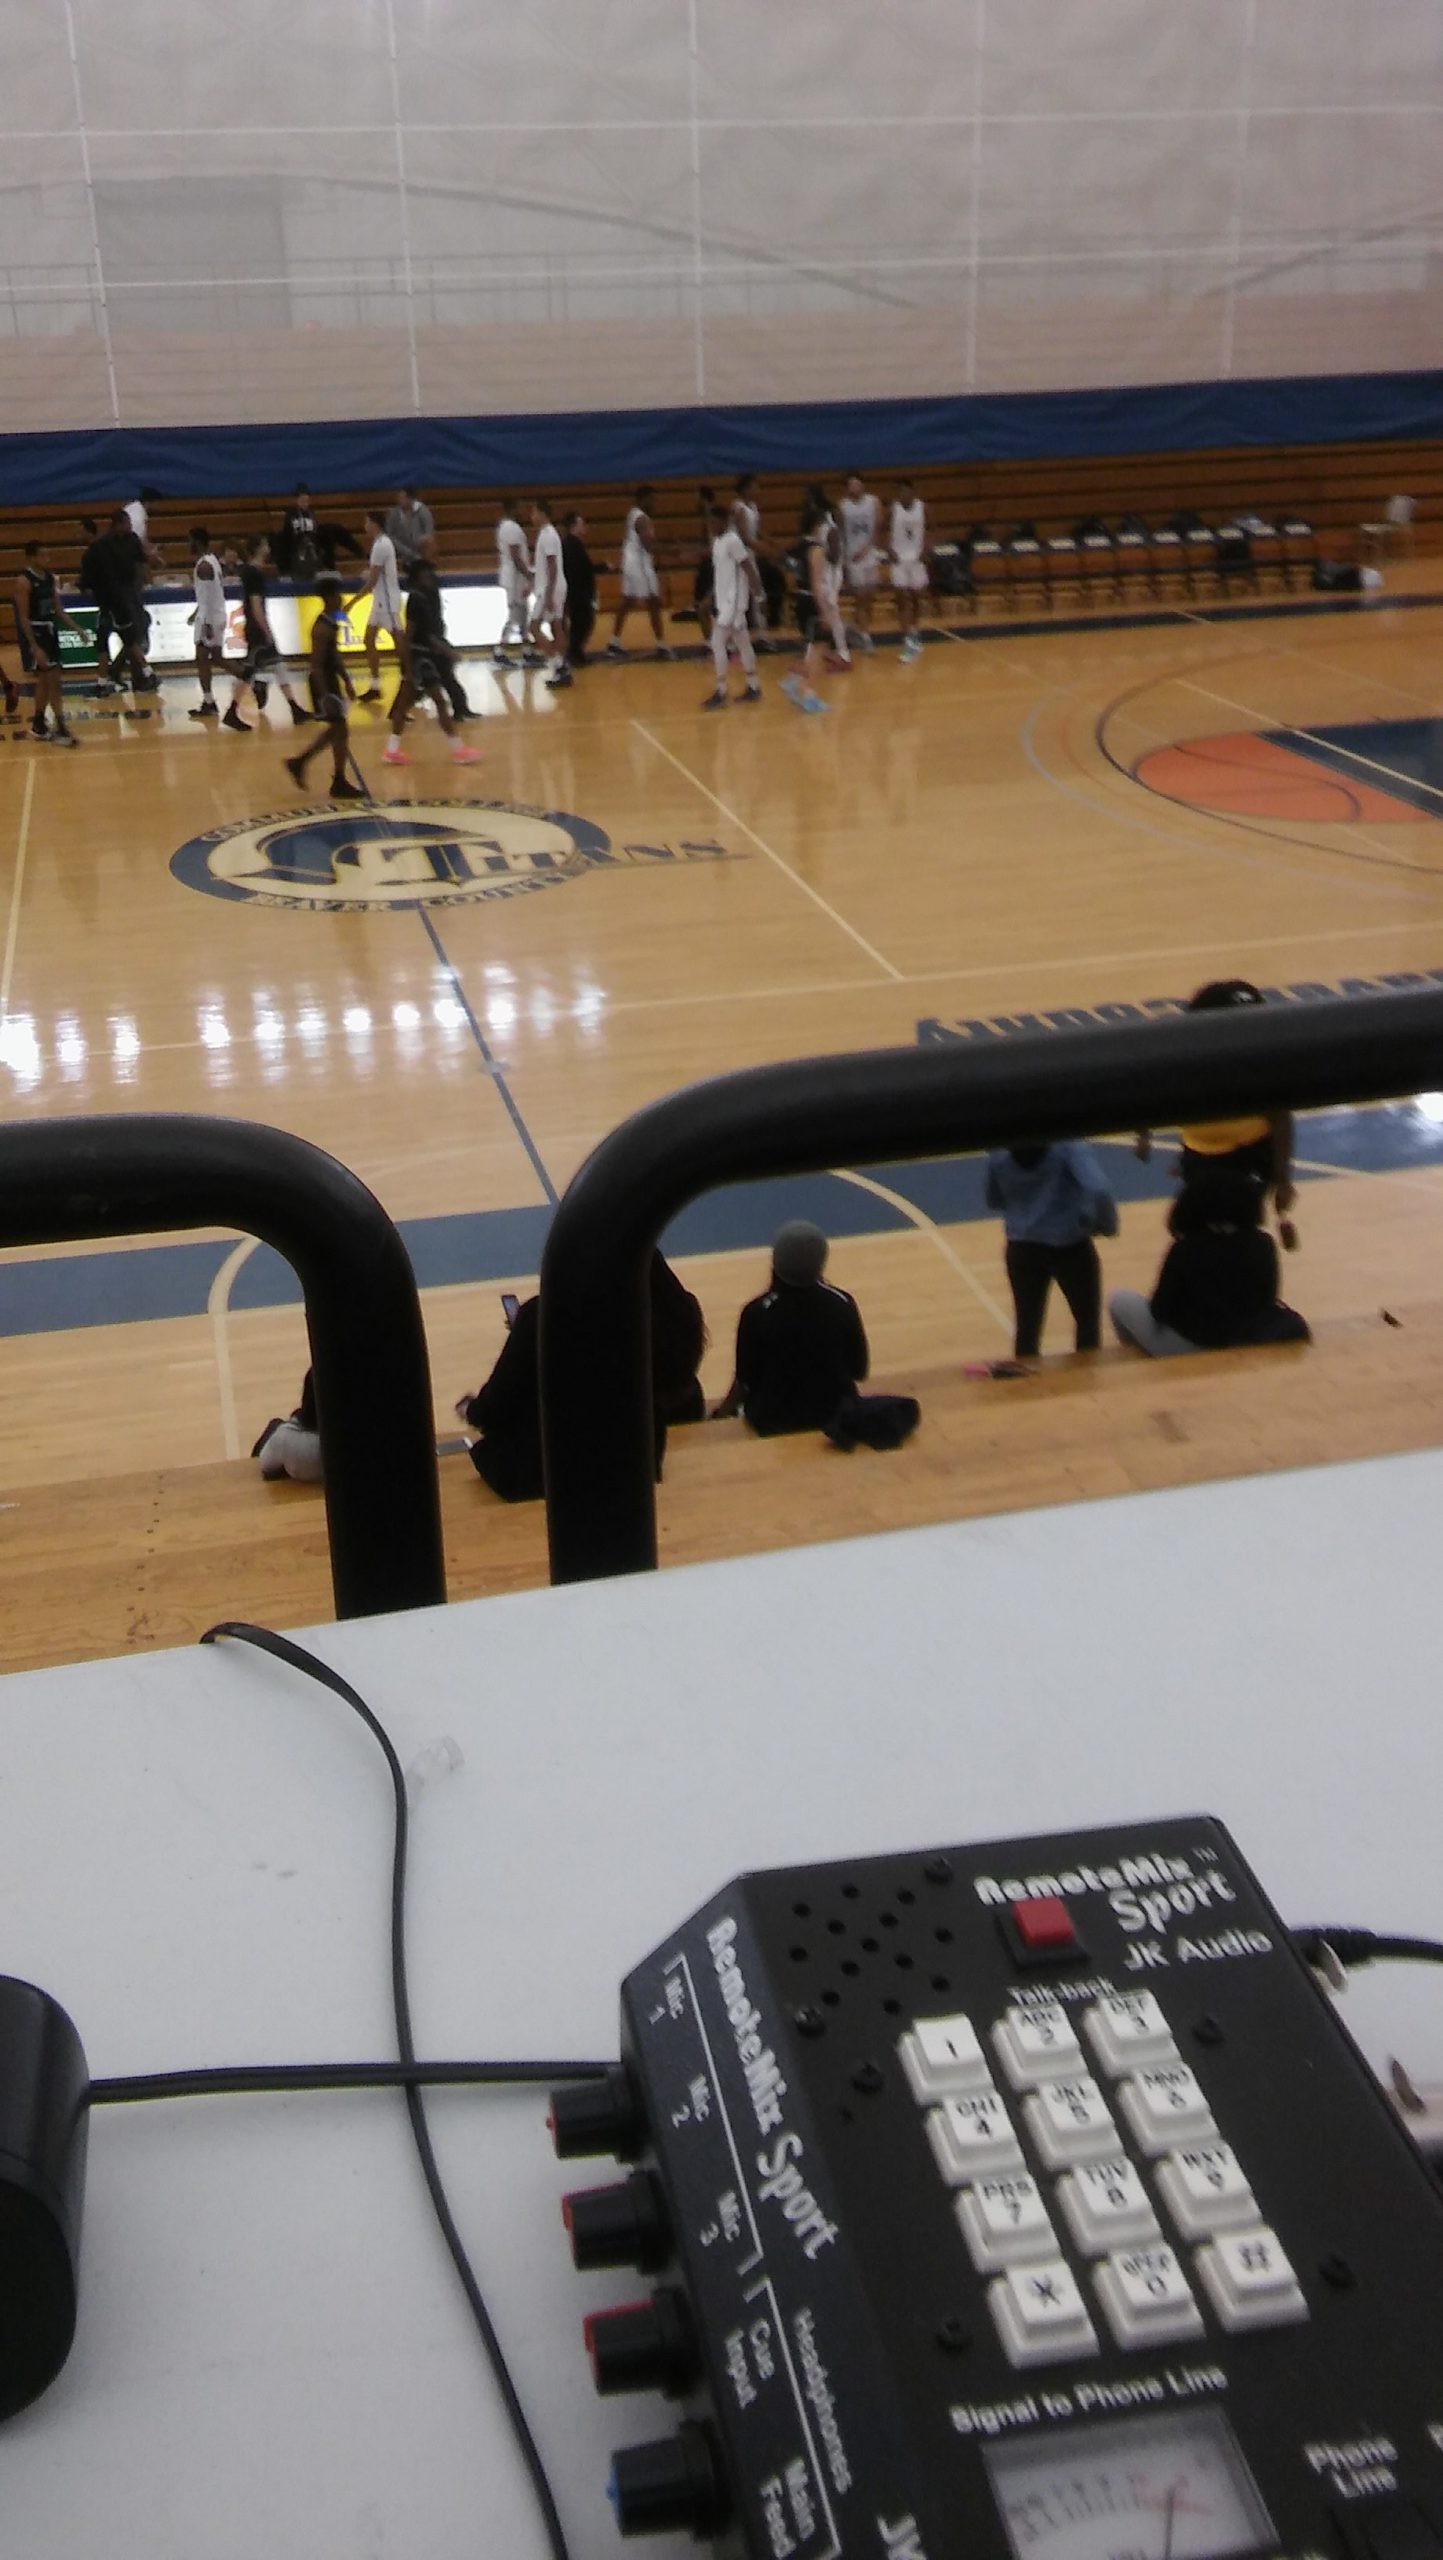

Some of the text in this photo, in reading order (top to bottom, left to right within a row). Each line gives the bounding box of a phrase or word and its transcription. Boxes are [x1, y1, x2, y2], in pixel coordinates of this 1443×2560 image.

[973, 1853, 1194, 1906] RemoteMix
[1108, 1869, 1237, 1935] Sport
[1124, 1928, 1273, 1972] JK Audio
[649, 2004, 667, 2025] 1
[664, 1975, 685, 2020] Mic
[945, 2037, 960, 2060] 1
[1039, 2024, 1056, 2046] 2
[687, 2073, 710, 2122] Mic
[706, 1916, 840, 2260] RemoteMix Sport
[1166, 2090, 1186, 2109] 6
[671, 2104, 691, 2129] 2
[976, 2116, 993, 2139] 4
[1070, 2103, 1091, 2123] 5
[1107, 2187, 1127, 2207] 8
[1205, 2170, 1226, 2191] 9
[718, 2189, 741, 2242] Mic
[1006, 2200, 1023, 2225] 7
[699, 2221, 719, 2247] 3
[725, 2327, 757, 2410] Input
[750, 2317, 775, 2381] Cue
[793, 2306, 853, 2495] Headphones
[949, 2363, 1228, 2436] Signal to Phone Line
[1303, 2437, 1399, 2474] Phone
[784, 2456, 816, 2541] Main
[1332, 2466, 1399, 2498] Line
[760, 2473, 797, 2560] Feed
